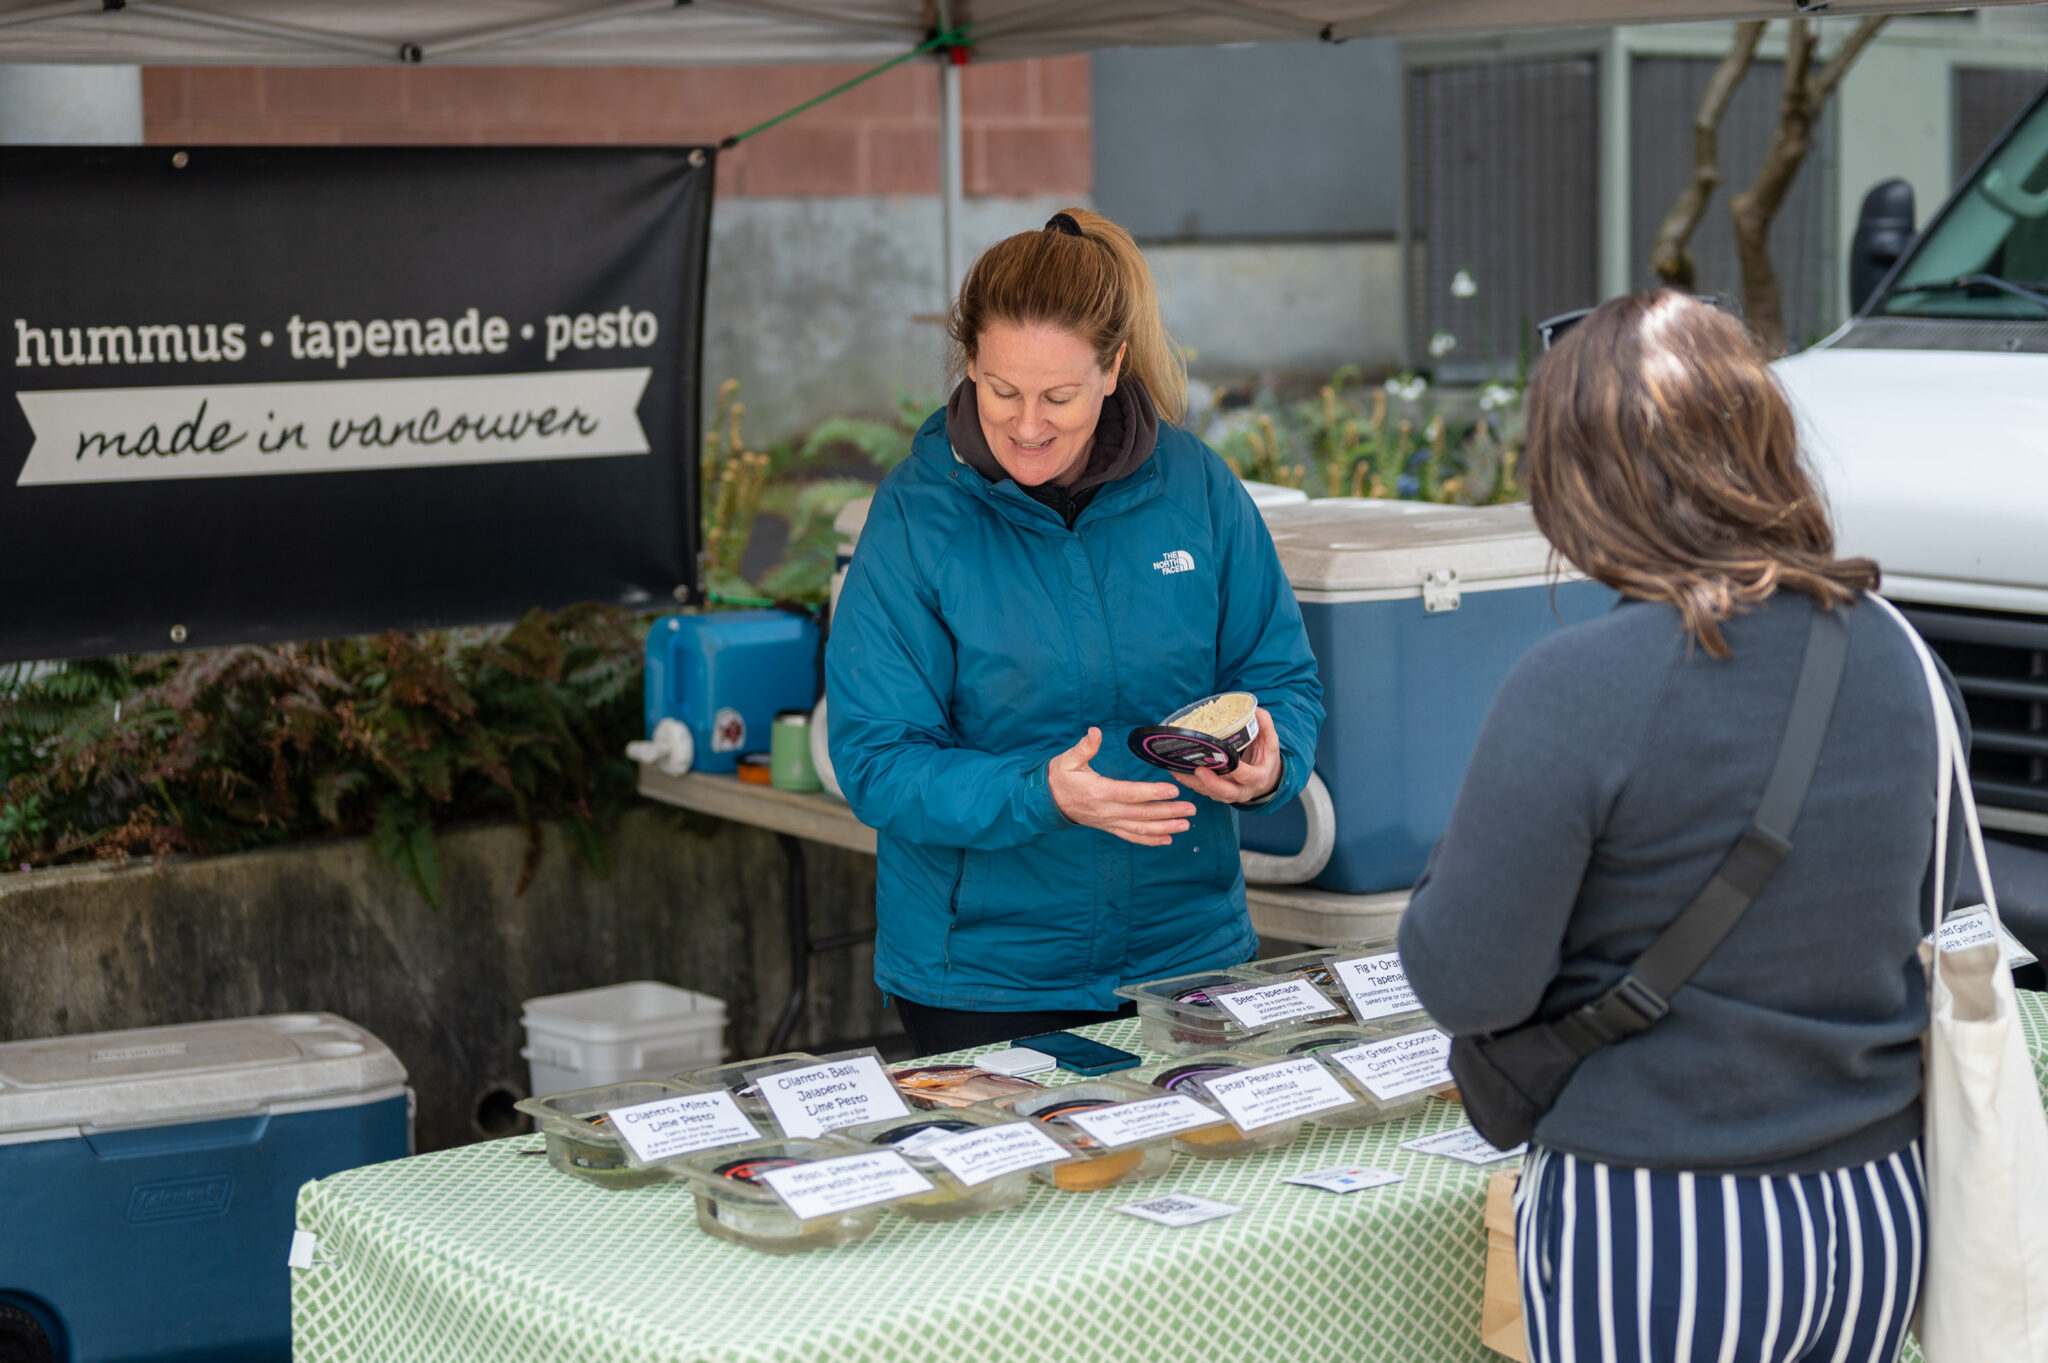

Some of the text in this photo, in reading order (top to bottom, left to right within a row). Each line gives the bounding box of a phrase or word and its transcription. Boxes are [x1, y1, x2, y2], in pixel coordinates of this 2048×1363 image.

[14, 307, 657, 369] hummus tapenade pesto
[75, 398, 599, 461] made in vancouver
[1153, 559, 1179, 570] NORTH
[1163, 551, 1178, 560] THE
[1162, 567, 1180, 576] FACE
[1953, 920, 1978, 934] Garlic
[1353, 964, 1371, 975] Fig
[1378, 959, 1404, 971] Oran
[1231, 985, 1301, 1005] Beet Tapenade
[1341, 1034, 1441, 1064] Thai Green Coconut
[1367, 1046, 1440, 1072] Curry Hummus
[778, 1065, 860, 1090] Cilantro, Basil,
[1215, 1080, 1245, 1095] Satay
[1244, 1070, 1286, 1085] Peanut
[1292, 1063, 1318, 1074] Yam
[796, 1082, 847, 1102] Jalapeno
[1251, 1081, 1299, 1099] Hummus
[625, 1106, 680, 1124] Cilantro,
[680, 1101, 710, 1112] Mint
[804, 1094, 869, 1117] Lime Pesto
[648, 1113, 715, 1133] Lime Pesto
[992, 1139, 1041, 1154] Hummus
[858, 1167, 909, 1181] Hummus
